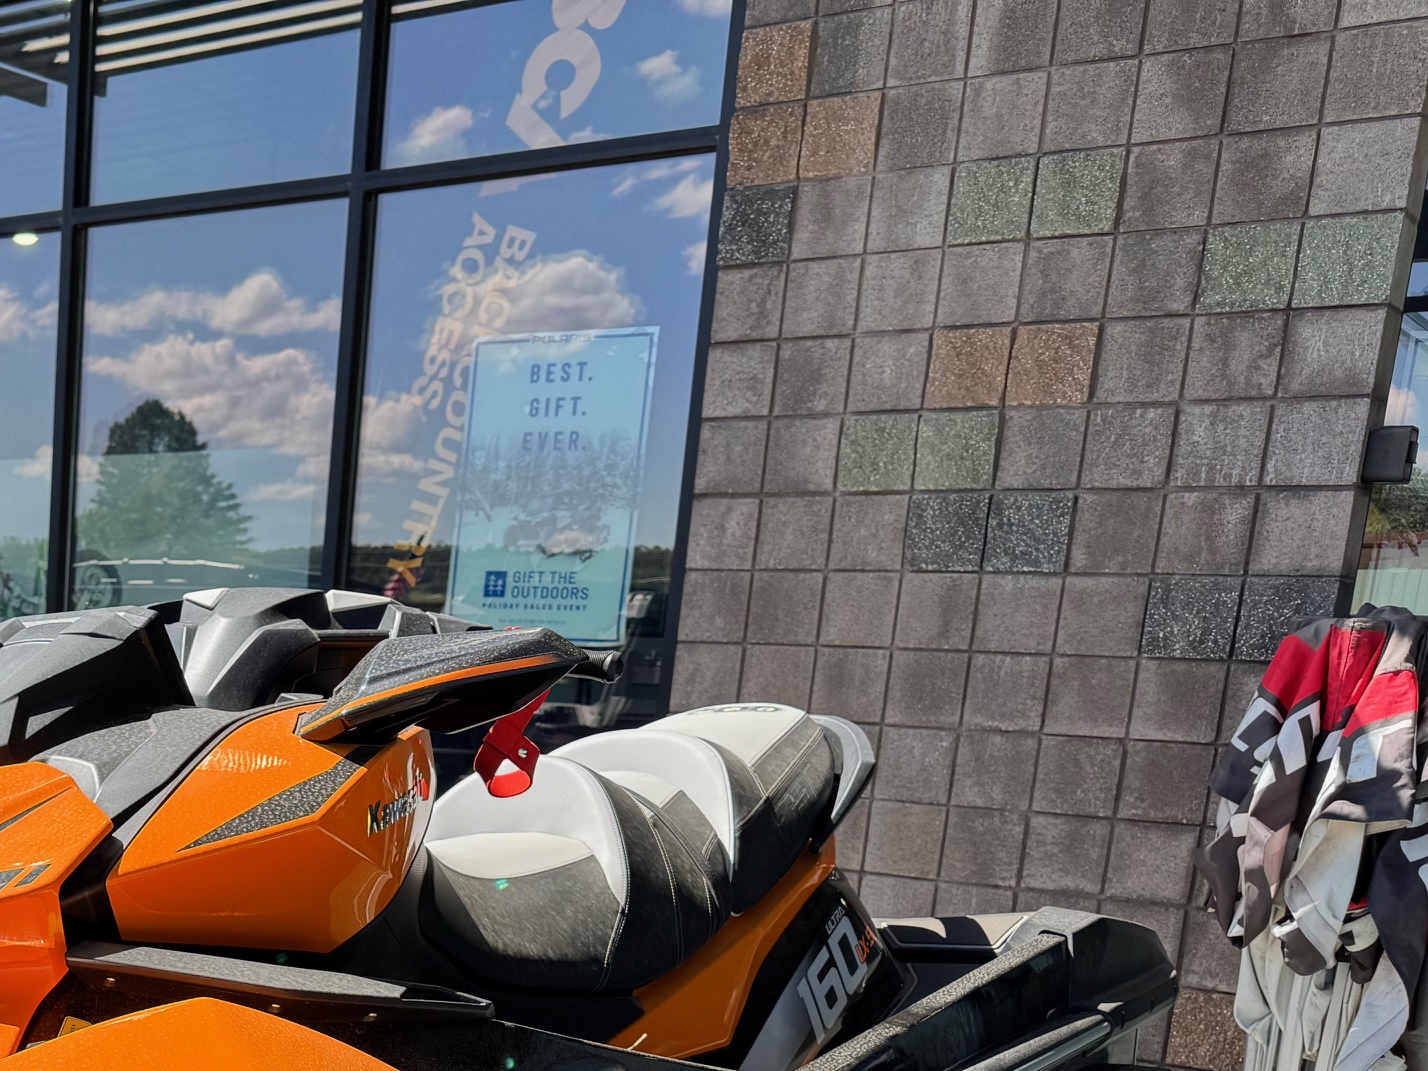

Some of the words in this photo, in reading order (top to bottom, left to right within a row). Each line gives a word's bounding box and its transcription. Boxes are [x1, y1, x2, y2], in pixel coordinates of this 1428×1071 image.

[410, 211, 497, 410] ACCESS
[532, 333, 592, 345] POLARIS
[529, 362, 593, 384] BEST.
[528, 396, 587, 418] GIFT.
[523, 431, 586, 452] EVER.
[512, 571, 545, 584] GIFT
[550, 571, 577, 584] THE
[510, 586, 589, 600] OUTDOORS
[825, 905, 846, 935] ULTRA
[797, 915, 868, 1045] 160
